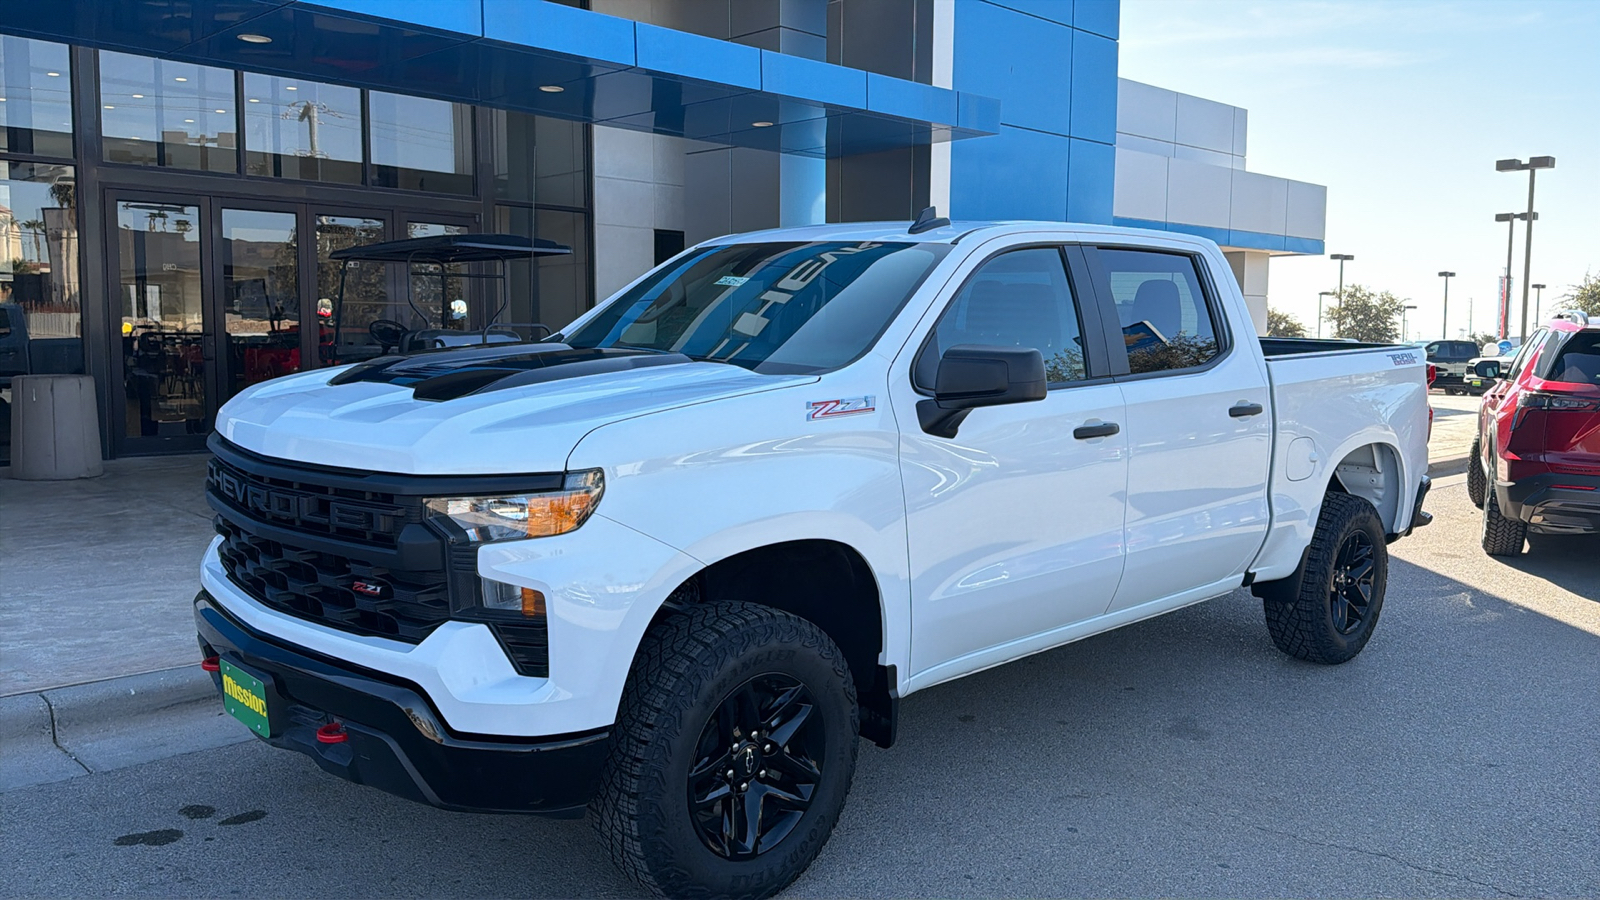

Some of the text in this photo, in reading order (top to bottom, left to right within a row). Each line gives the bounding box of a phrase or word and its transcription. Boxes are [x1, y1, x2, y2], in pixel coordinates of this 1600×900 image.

[806, 396, 876, 422] Z71
[207, 463, 405, 533] CHEVROLET
[352, 581, 382, 595] Z71
